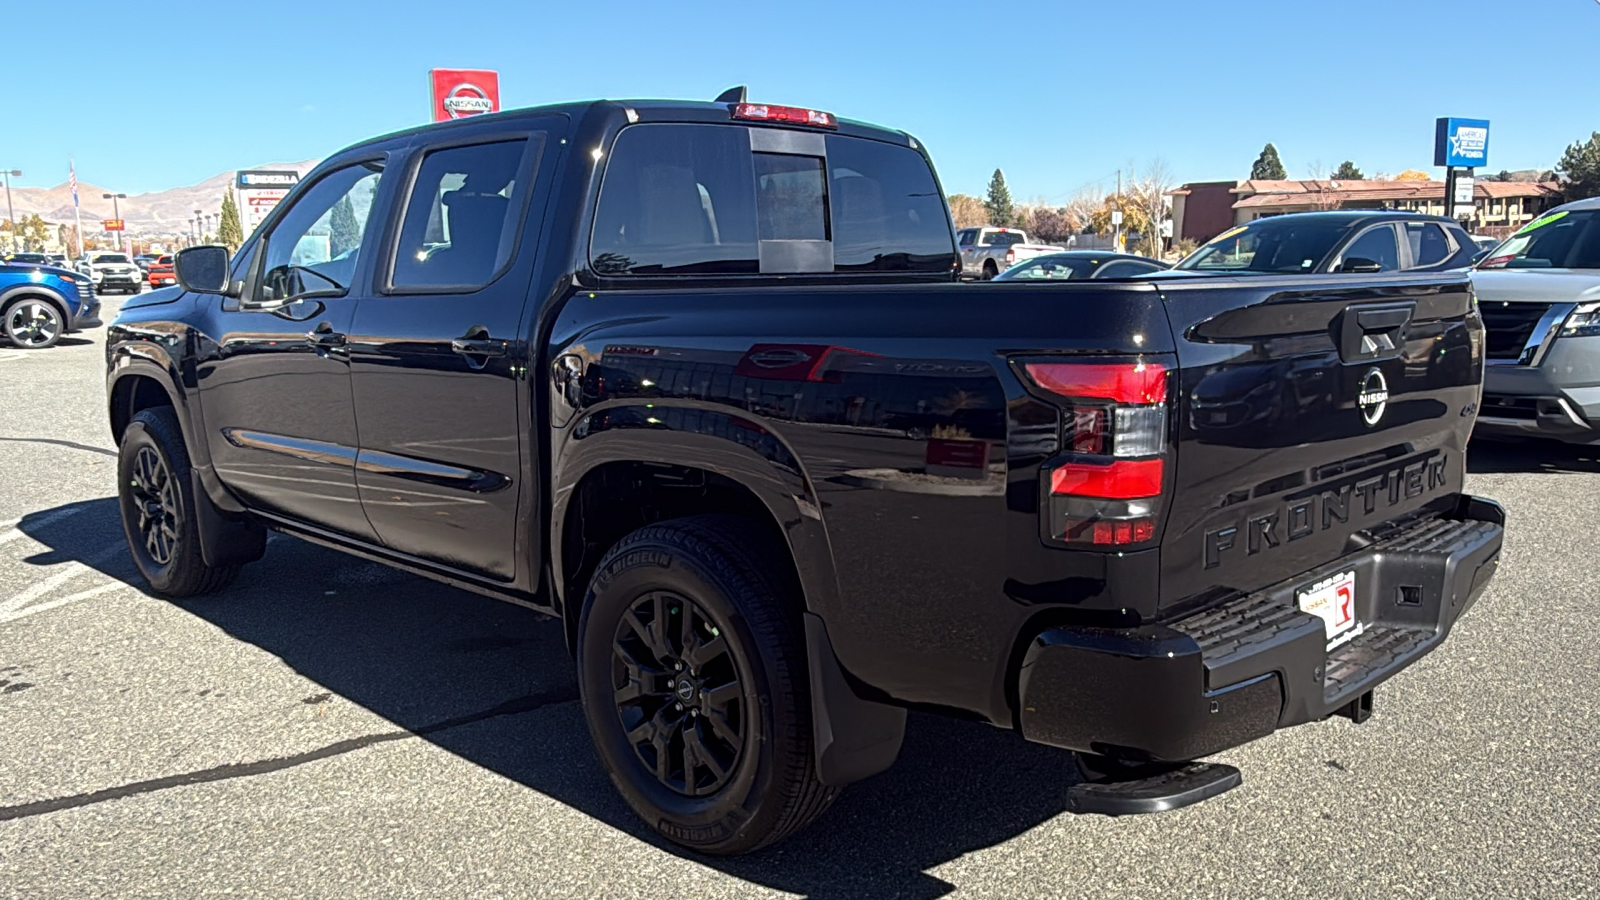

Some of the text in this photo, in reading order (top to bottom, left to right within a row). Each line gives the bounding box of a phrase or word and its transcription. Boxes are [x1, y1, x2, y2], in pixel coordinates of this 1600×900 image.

[449, 100, 489, 109] NISSAN
[1358, 391, 1388, 405] NISSAN
[1204, 453, 1448, 571] FRONTIER
[612, 551, 671, 575] MICHELIN
